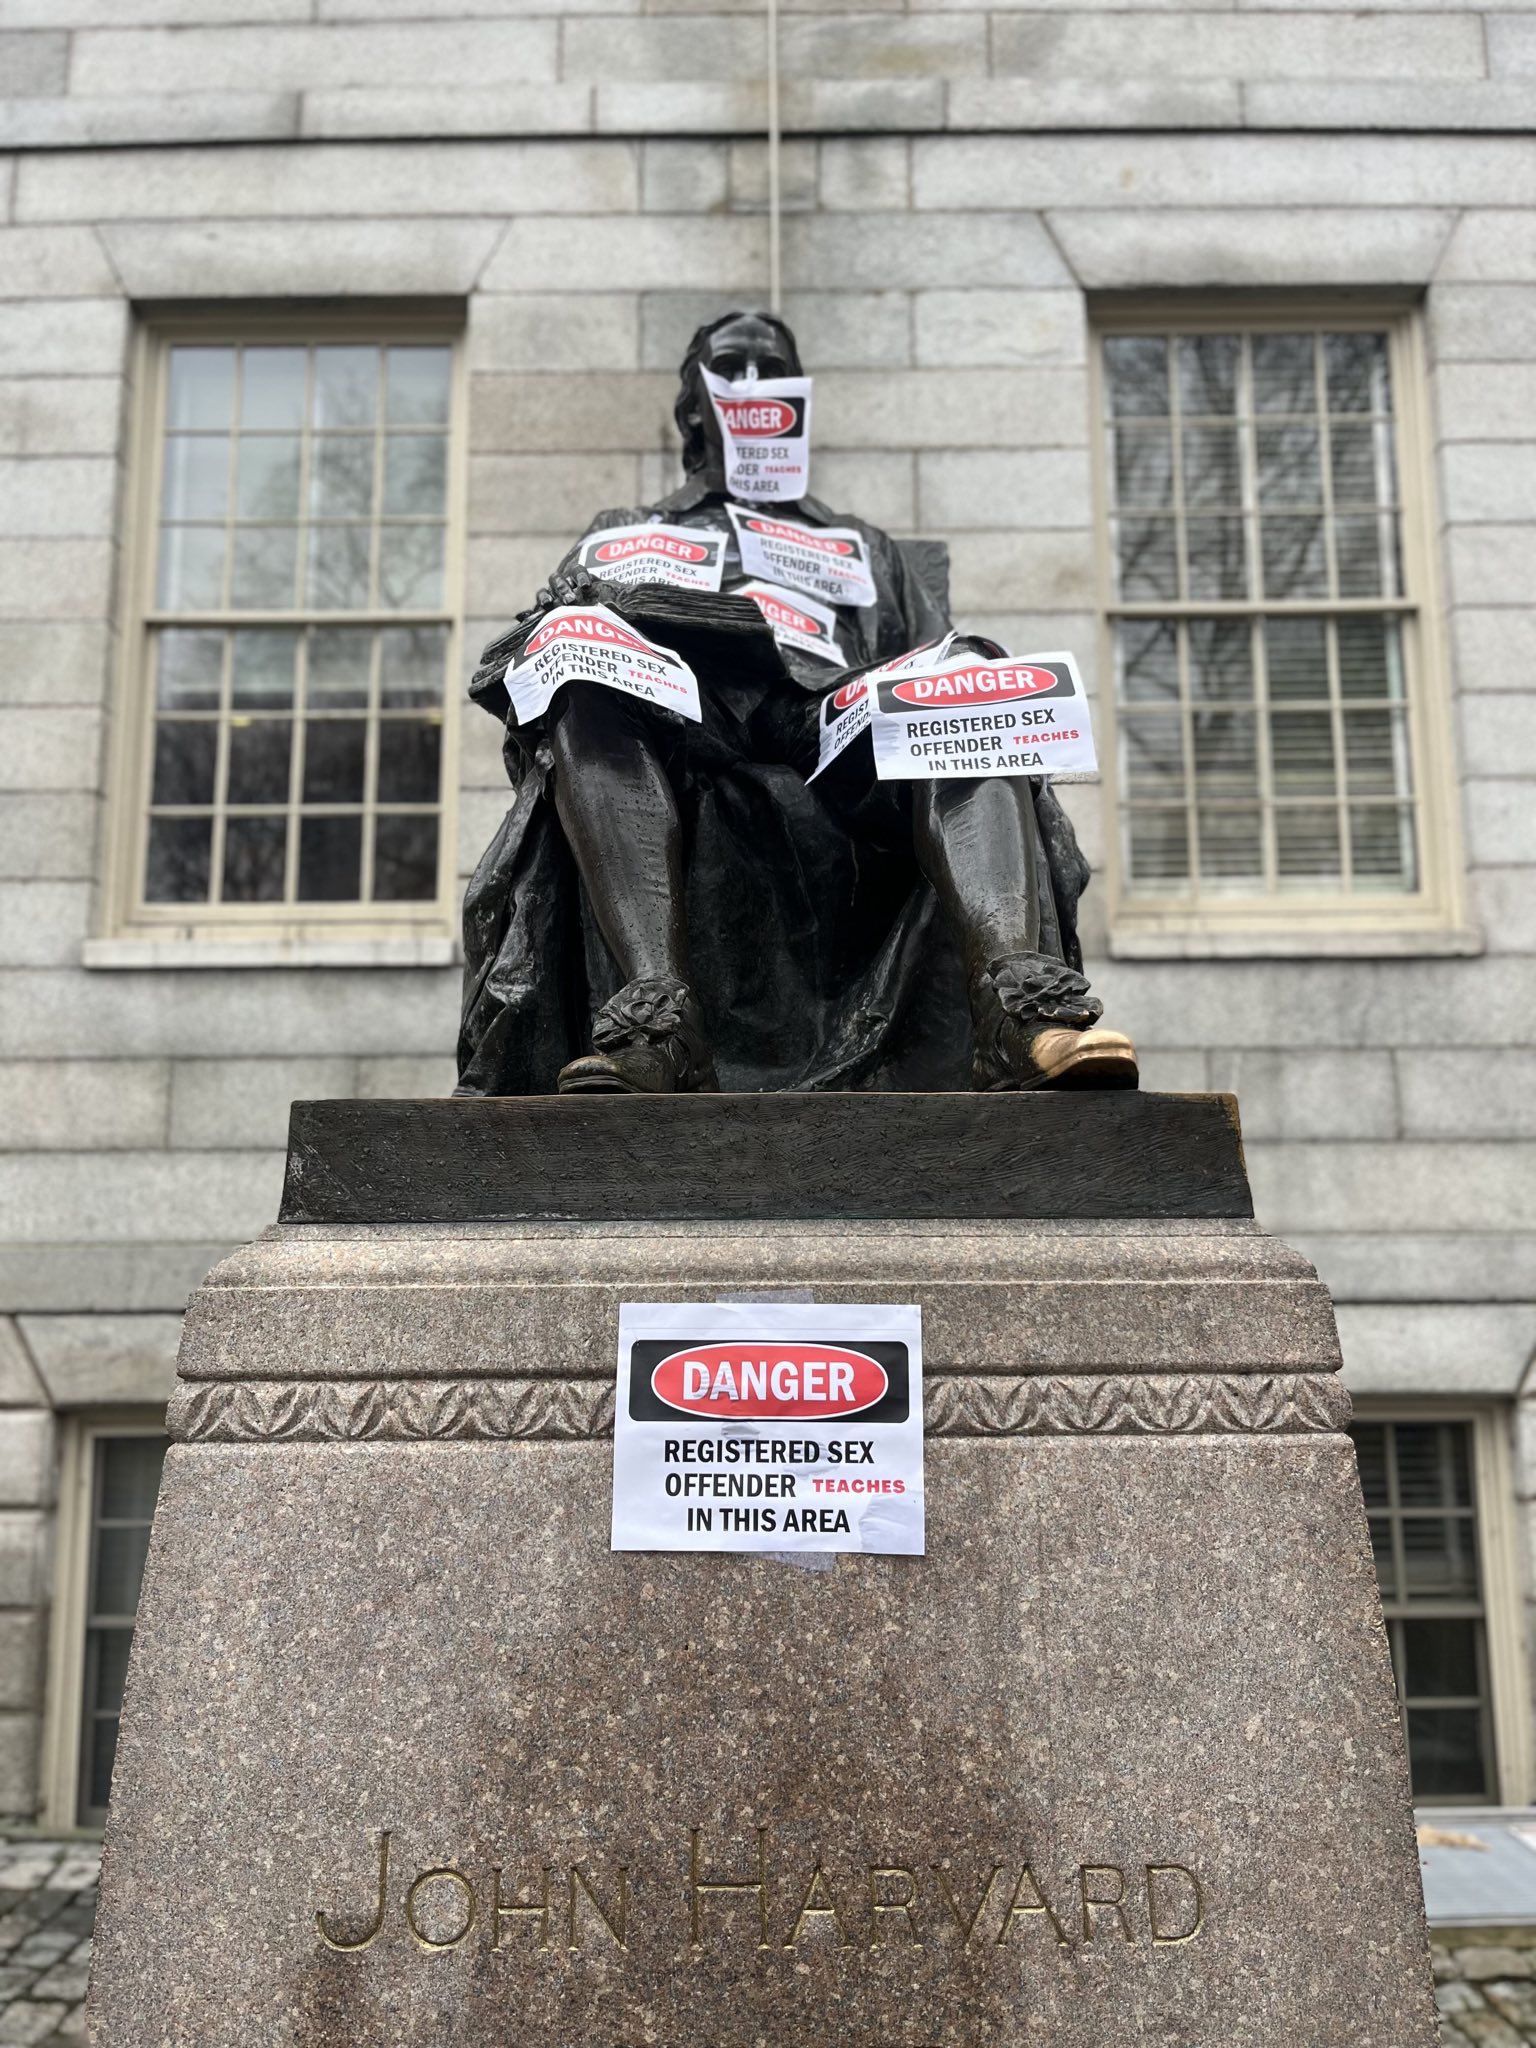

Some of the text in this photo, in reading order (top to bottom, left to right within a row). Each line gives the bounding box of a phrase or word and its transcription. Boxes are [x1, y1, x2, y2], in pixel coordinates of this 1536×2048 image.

[724, 407, 782, 430] ANGER
[736, 446, 789, 459] TERED SEX
[752, 481, 779, 492] AREA
[608, 536, 692, 559] DANGER
[759, 522, 839, 550] DANGER
[760, 537, 831, 564] REGISTERED
[763, 550, 820, 575] OFFENDER
[600, 558, 697, 579] REGISTERED SEX
[613, 566, 658, 582] FENDER
[813, 579, 843, 594] AREA
[525, 642, 668, 676] REGISTERED SEX
[540, 651, 688, 695] OFFENDER TEACHES
[551, 663, 655, 698] IN THIS AREA
[914, 669, 1036, 699] DANGER
[836, 698, 869, 736] REGIST
[907, 708, 1056, 739] REGISTERED SEX
[910, 729, 1080, 757] OFFENDER TEACHES
[928, 752, 1044, 771] IN THIS AREA
[682, 1360, 857, 1402] DANGER
[664, 1439, 875, 1464] REGISTERED SEX
[664, 1472, 906, 1498] OFFENDER TEACHES
[686, 1507, 851, 1533] IN THIS AREA
[316, 1827, 1206, 1952] JOHN HARVARD
